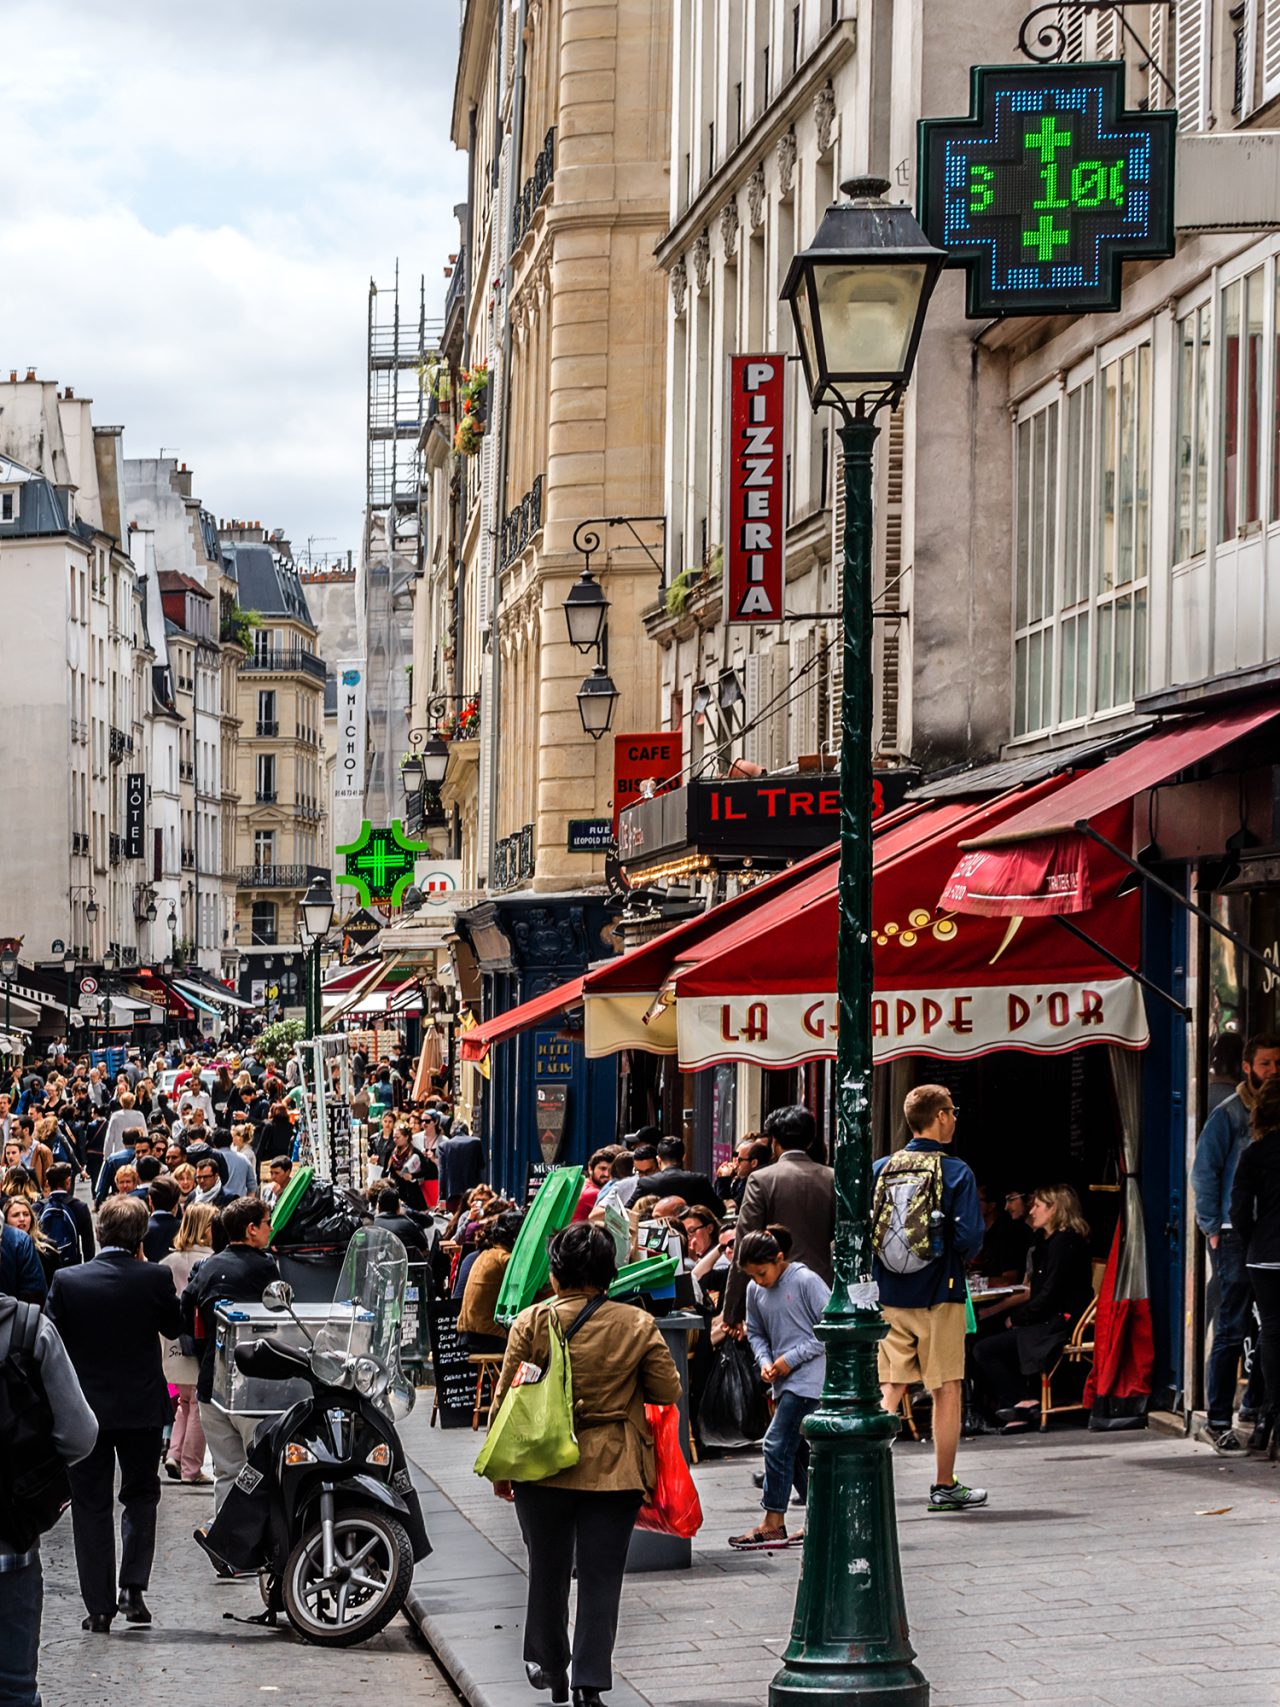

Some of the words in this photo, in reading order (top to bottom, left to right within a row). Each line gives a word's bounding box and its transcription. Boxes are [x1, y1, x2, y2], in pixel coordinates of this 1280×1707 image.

[739, 363, 775, 616] PIZZERIA
[344, 694, 356, 786] MICHOT
[628, 746, 671, 760] CAFE
[618, 777, 680, 793] BISRO
[130, 777, 142, 855] HÔTEL
[710, 791, 747, 821] IL
[574, 836, 601, 845] LEOPOLD
[589, 826, 610, 834] RUE
[721, 1002, 768, 1042] LA
[802, 994, 974, 1040] GAPPE
[1007, 988, 1105, 1033] D'OR
